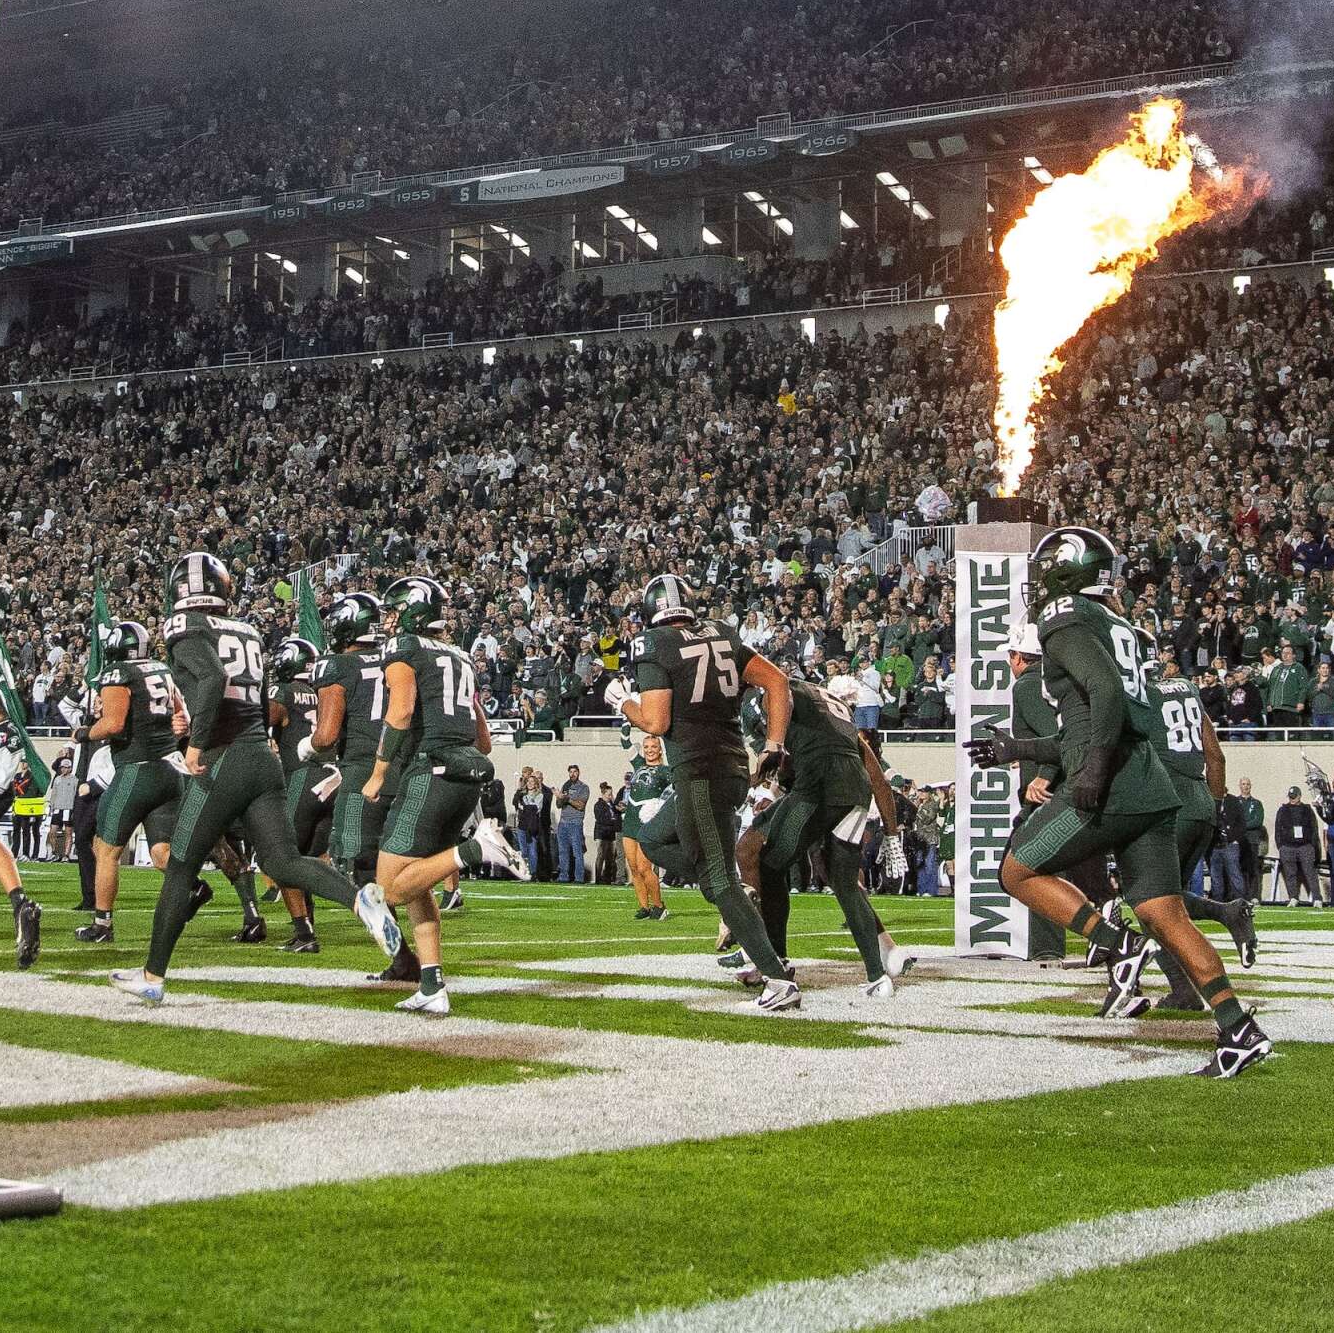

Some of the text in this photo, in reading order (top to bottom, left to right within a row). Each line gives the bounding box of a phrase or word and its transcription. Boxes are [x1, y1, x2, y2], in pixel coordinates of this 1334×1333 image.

[654, 155, 691, 168] 1957
[730, 146, 768, 159] 1965
[397, 190, 431, 202] 1955
[484, 171, 618, 196] NATIONAL CHAMPIONS
[273, 208, 301, 218] 1951
[333, 199, 365, 211] 1952
[1042, 596, 1075, 622] 92
[970, 557, 1011, 691] STATE
[679, 640, 740, 704] 75
[435, 656, 477, 721] 14
[1162, 697, 1204, 753] 88
